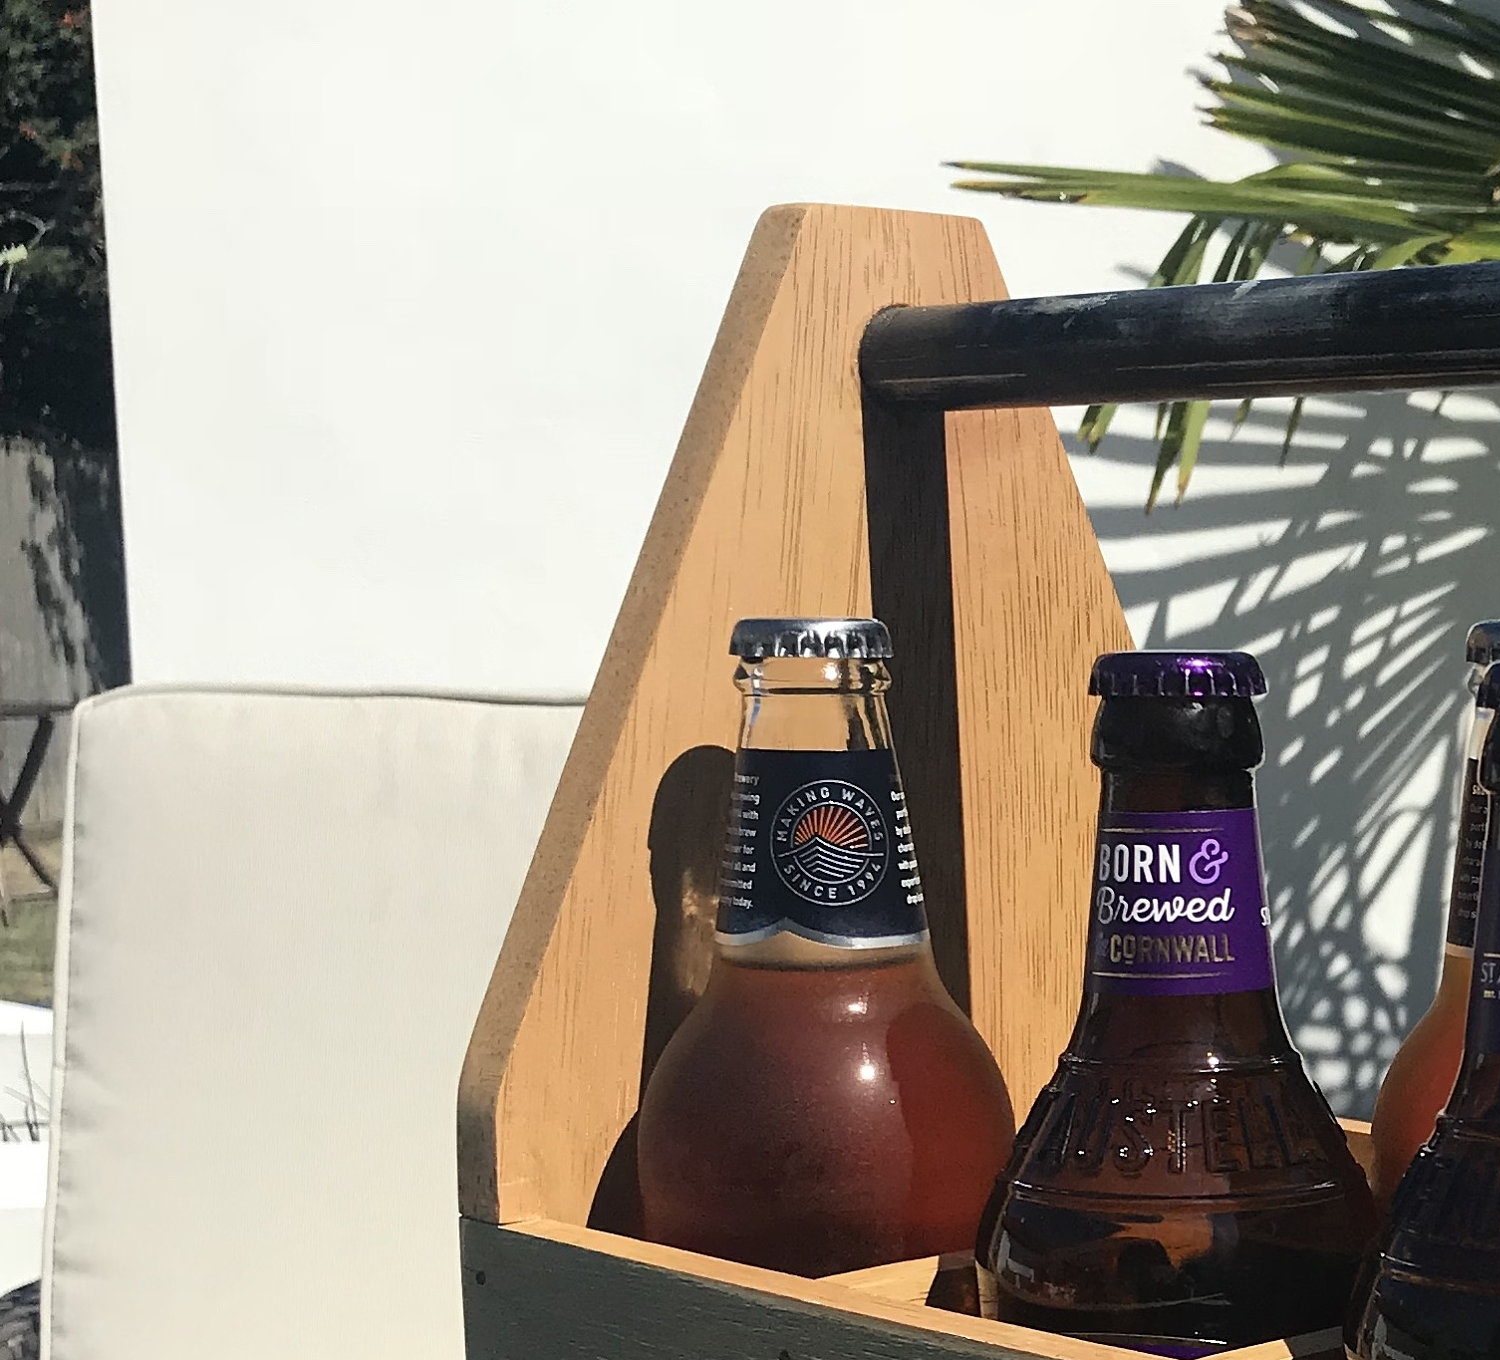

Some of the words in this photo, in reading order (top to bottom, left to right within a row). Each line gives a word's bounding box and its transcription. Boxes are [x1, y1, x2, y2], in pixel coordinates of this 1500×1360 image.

[777, 787, 830, 841] MAKING
[842, 788, 884, 841] WAVES
[1099, 843, 1181, 883] BORN
[1189, 838, 1229, 884] &
[784, 863, 837, 899] SINCE
[848, 863, 881, 896] 1994
[1096, 886, 1235, 924] Brewed
[1109, 932, 1235, 965] CORNWALL
